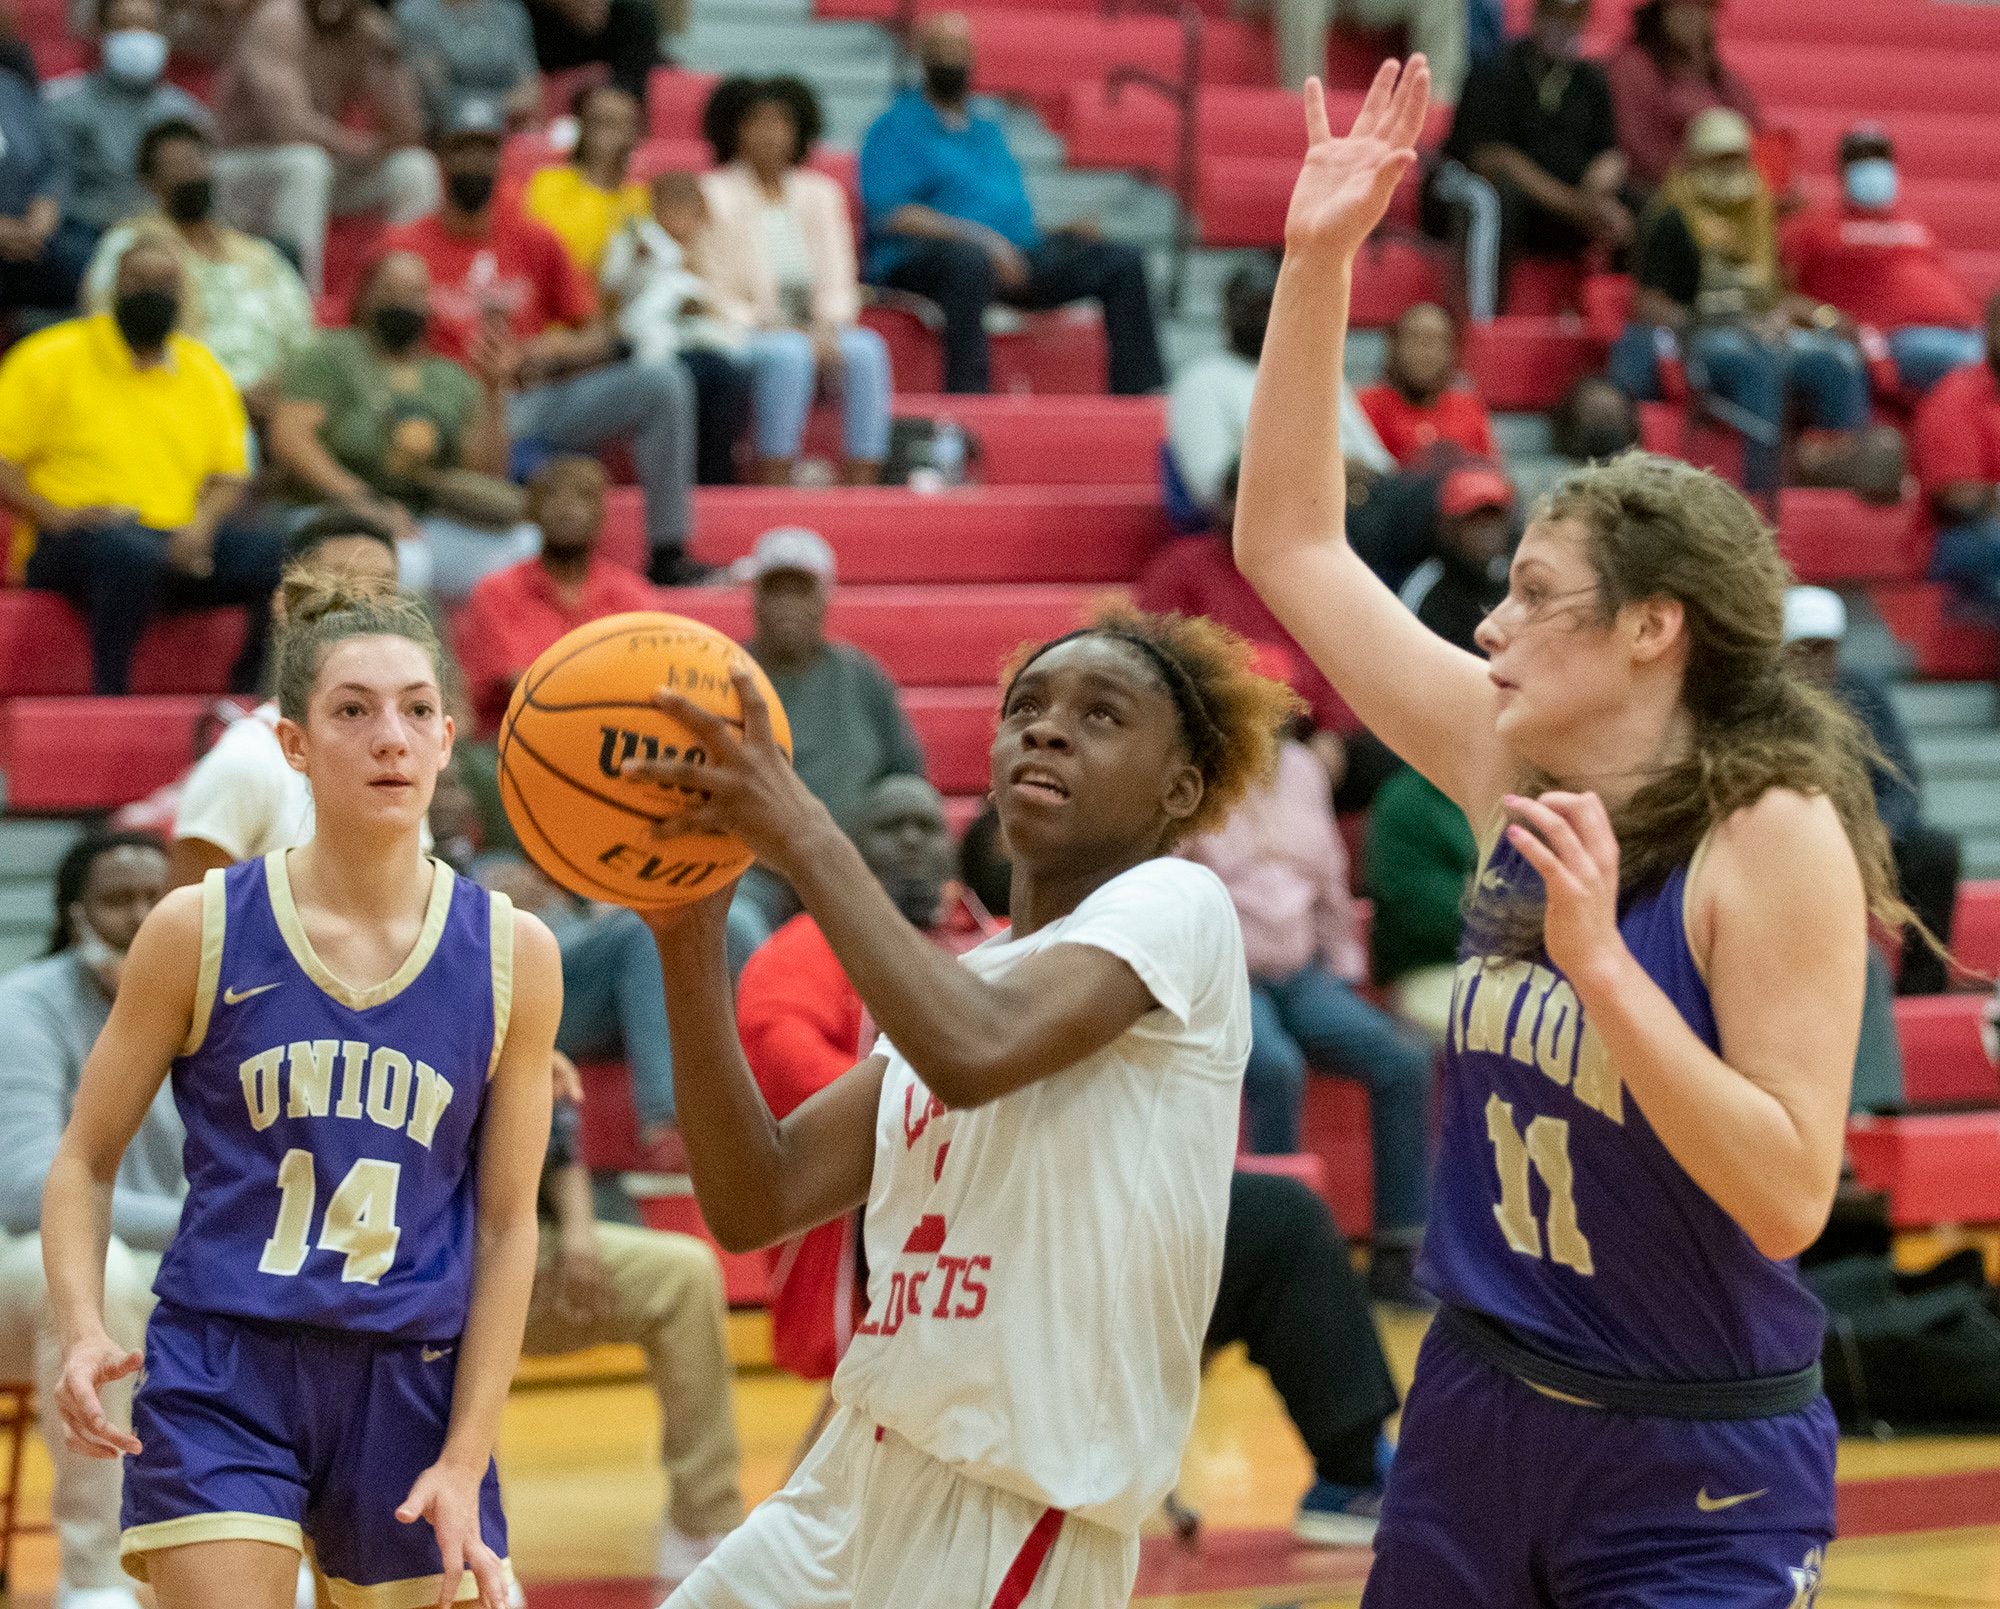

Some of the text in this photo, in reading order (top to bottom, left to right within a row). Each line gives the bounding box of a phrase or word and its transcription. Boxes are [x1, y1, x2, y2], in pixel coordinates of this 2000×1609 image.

[239, 1038, 454, 1151] UNION
[257, 1147, 402, 1286] 14
[1485, 1092, 1596, 1277] 11
